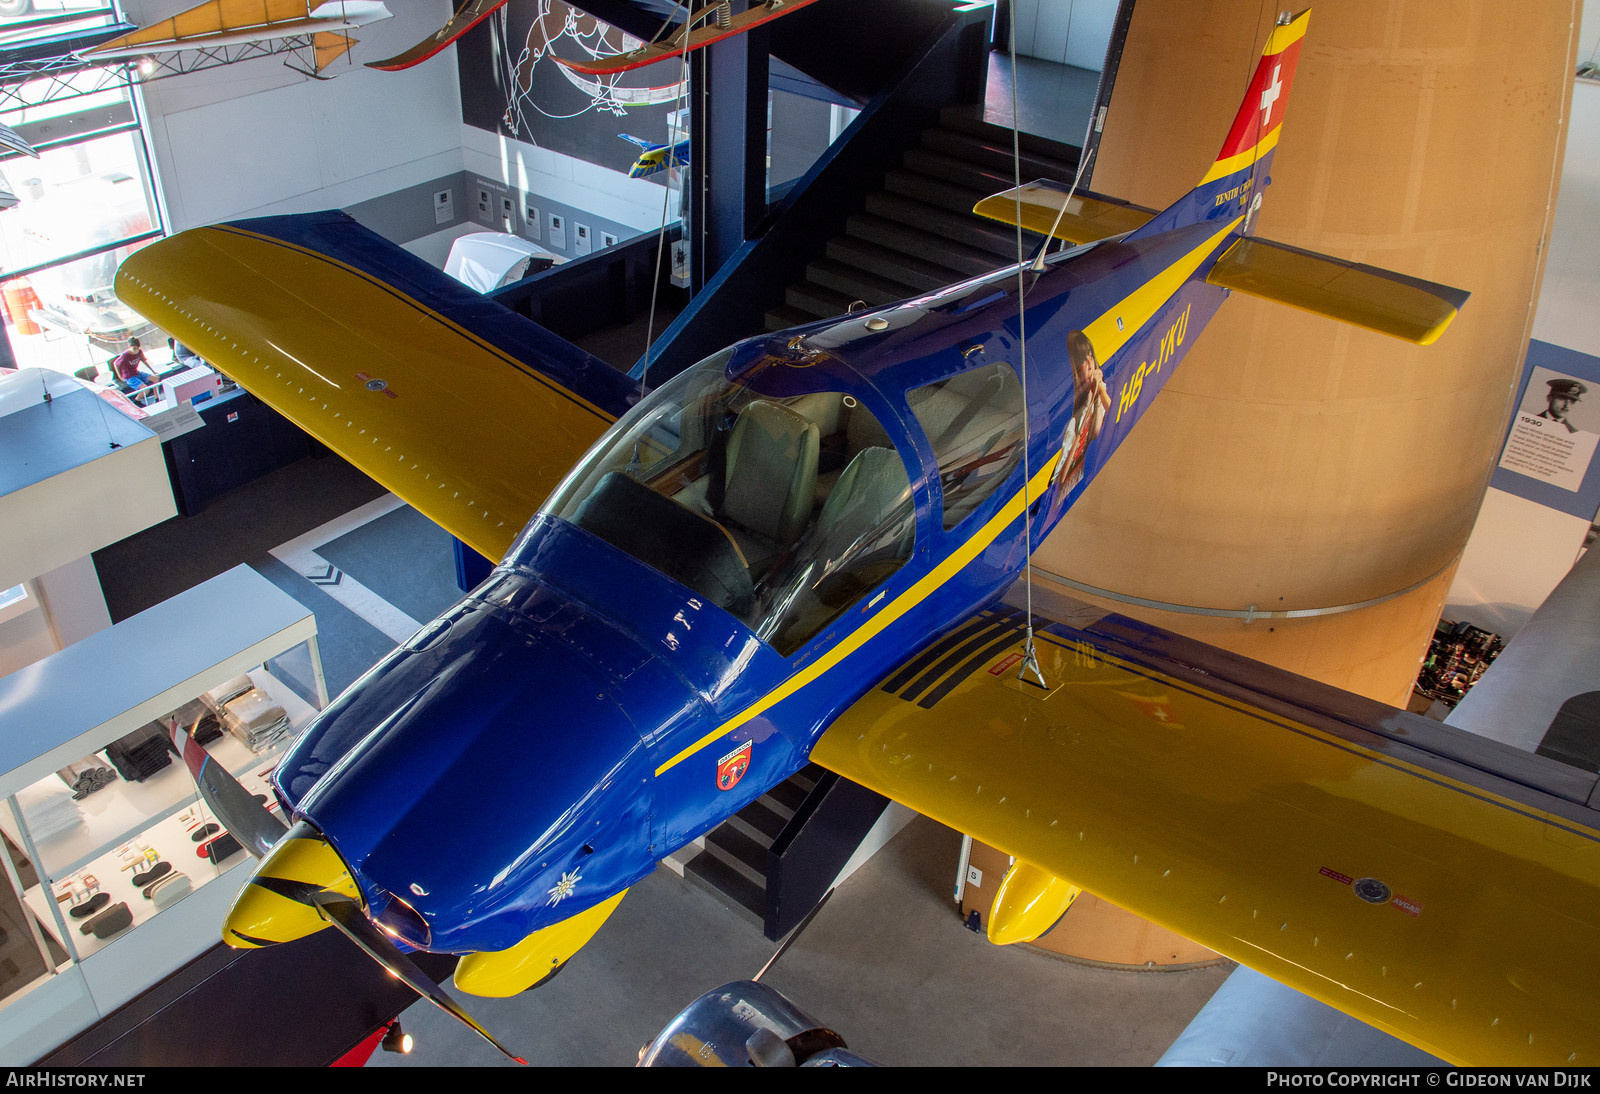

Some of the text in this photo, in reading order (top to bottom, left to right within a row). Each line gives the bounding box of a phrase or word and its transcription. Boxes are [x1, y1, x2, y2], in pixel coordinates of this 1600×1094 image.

[1215, 186, 1239, 206] ZENITH
[1116, 303, 1191, 424] HB-YKU
[1521, 416, 1543, 427] 1930
[1393, 898, 1421, 914] AVGAS
